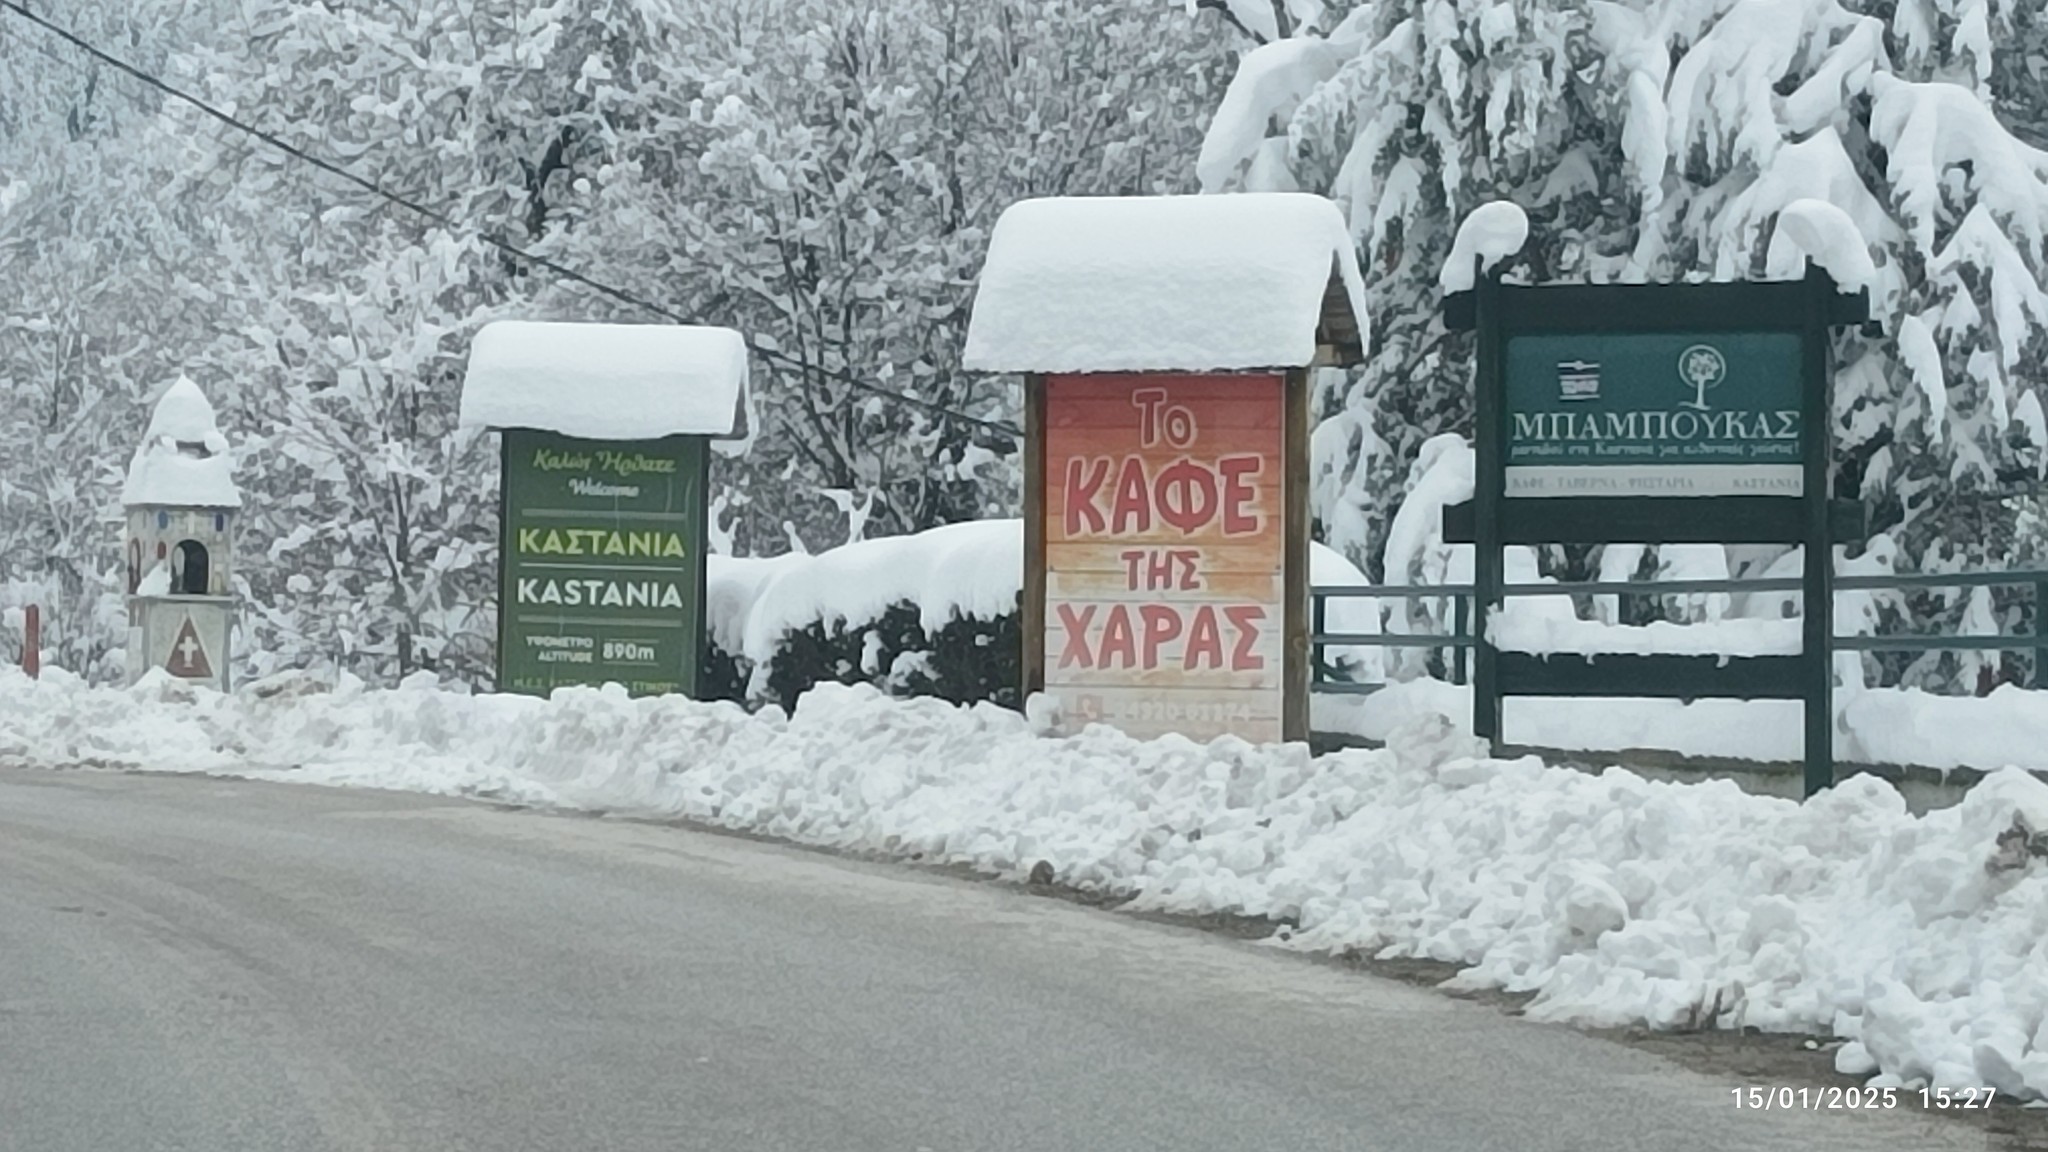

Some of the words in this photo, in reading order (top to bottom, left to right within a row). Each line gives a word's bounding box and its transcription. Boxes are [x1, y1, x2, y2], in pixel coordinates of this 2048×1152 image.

[1133, 388, 1196, 448] Το
[1512, 411, 1800, 440] ΜΠΑΜΠΟΥΚΑΣ
[568, 476, 640, 497] Welcome
[1065, 454, 1264, 537] ΚΑΦΕ
[1732, 477, 1800, 489] ΚΑΣΤΑΝΙΑ
[519, 528, 685, 558] ΚΑΣΤΑΝΙΑ
[1120, 549, 1200, 591] ΤΗΣ
[517, 578, 683, 608] KASTANIA
[603, 642, 655, 660] 890m
[1056, 603, 1267, 671] ΧΑΡΑΣ
[538, 651, 593, 663] ALTITUDE
